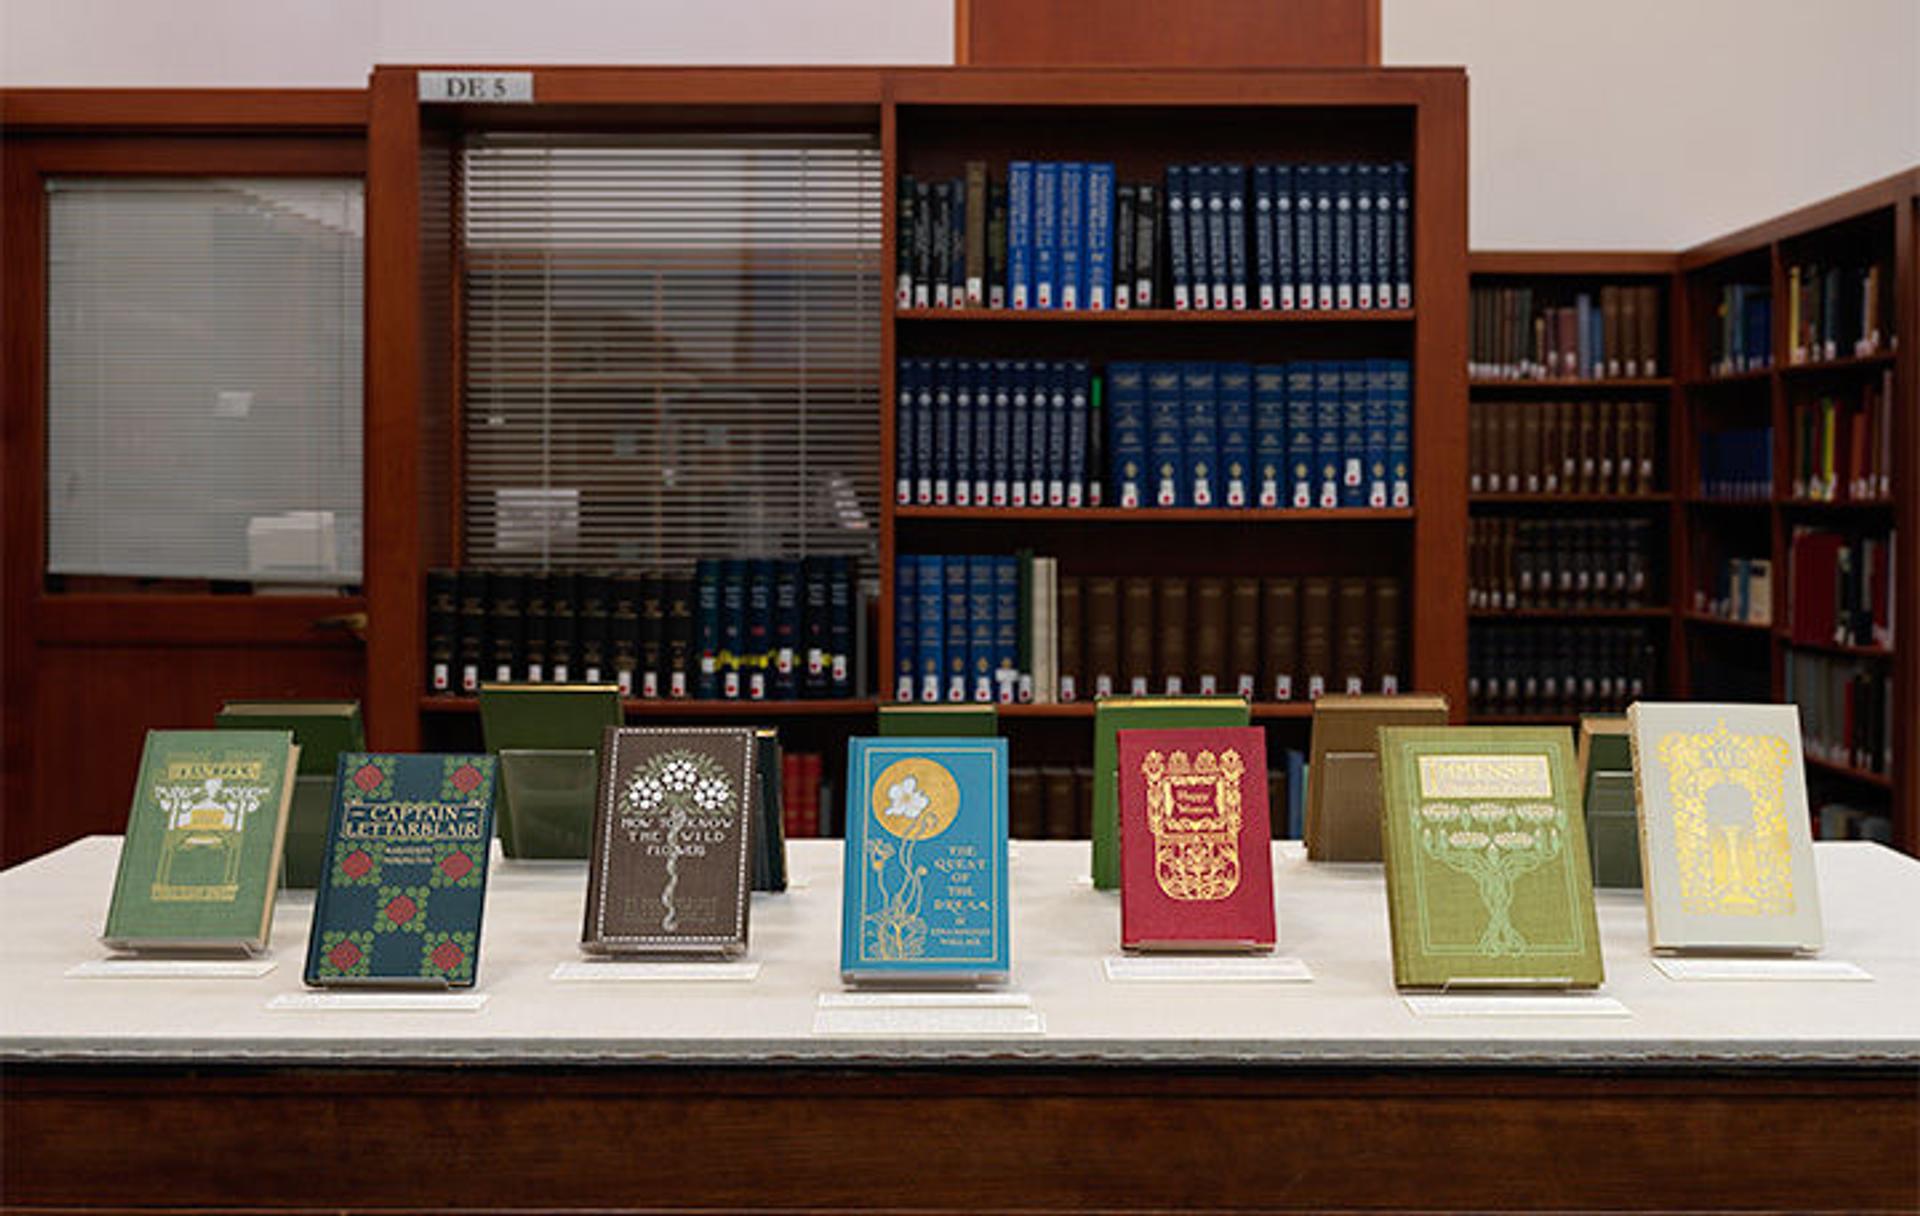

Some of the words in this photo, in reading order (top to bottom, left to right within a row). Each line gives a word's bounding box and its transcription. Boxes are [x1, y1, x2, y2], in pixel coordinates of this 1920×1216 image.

[447, 77, 487, 98] DE
[494, 77, 507, 98] 5
[370, 804, 460, 820] CAPTAIN
[345, 821, 479, 837] LETTARBLAIR
[688, 816, 733, 829] KNOW
[680, 830, 725, 842] WILD
